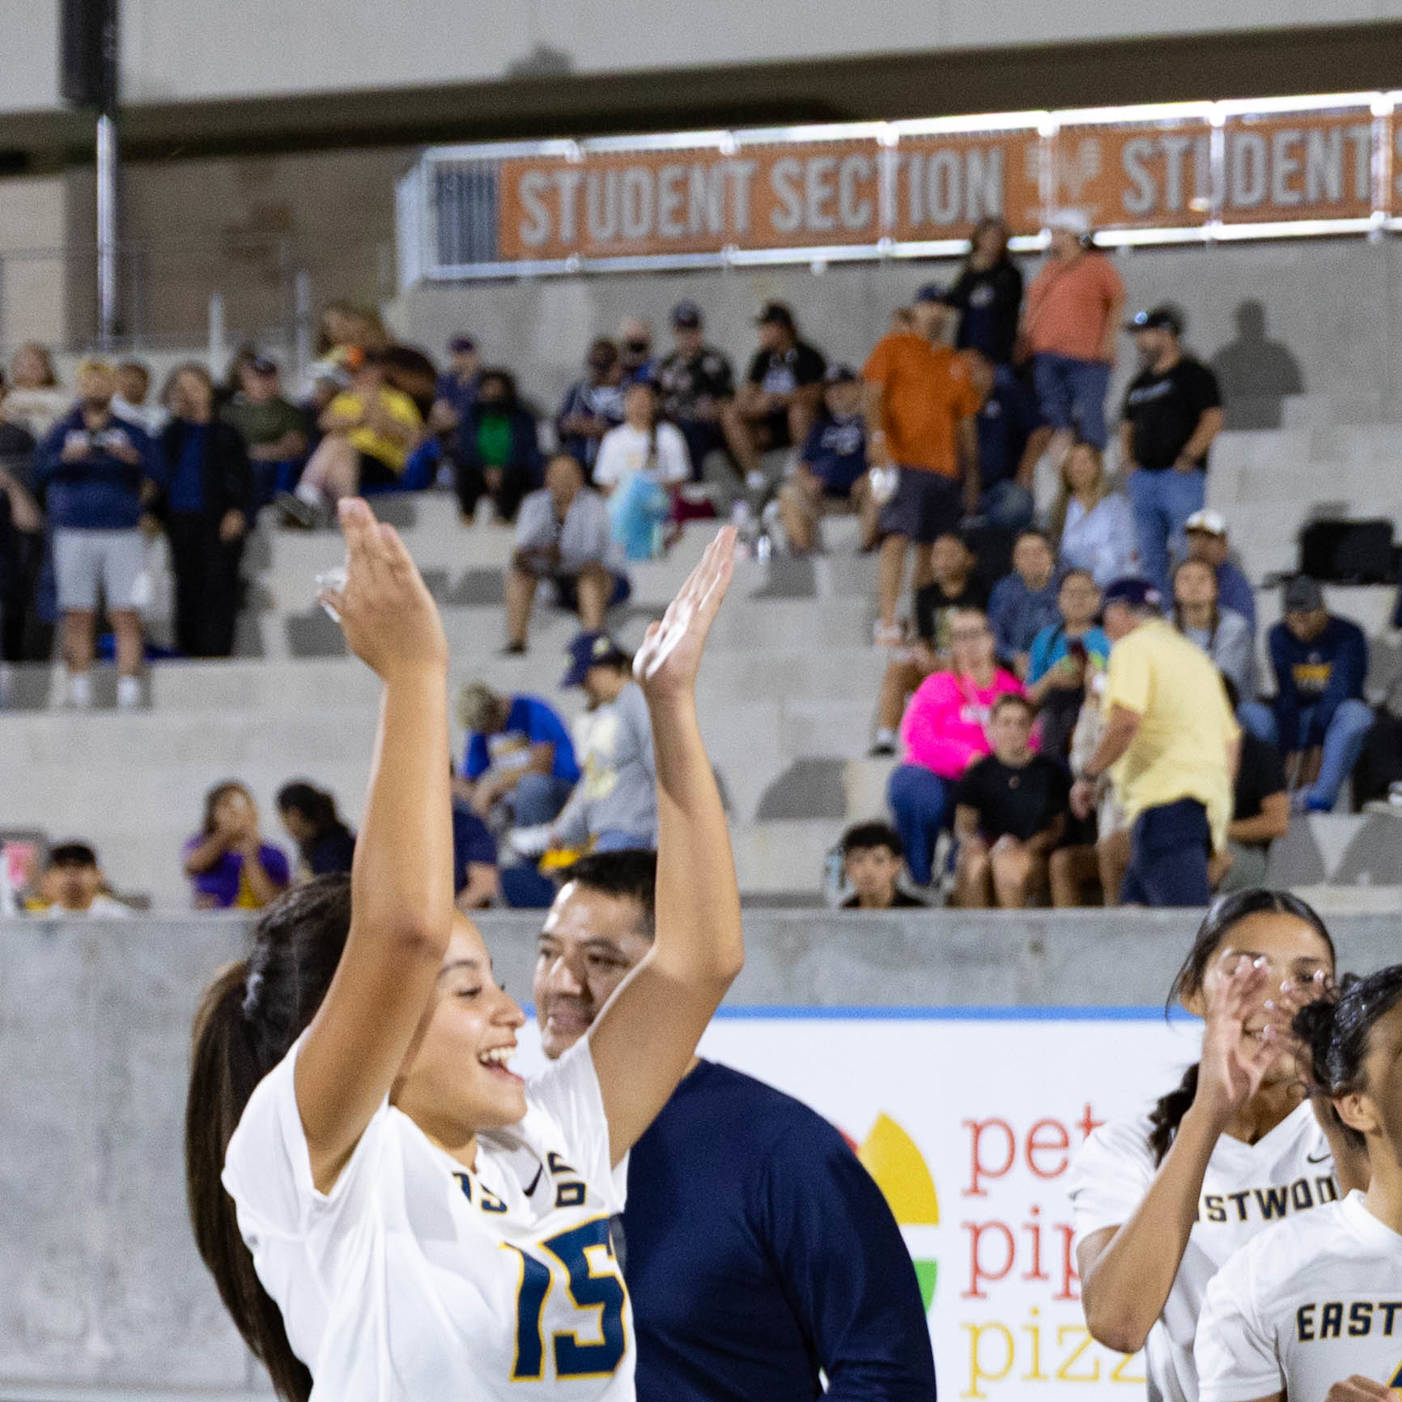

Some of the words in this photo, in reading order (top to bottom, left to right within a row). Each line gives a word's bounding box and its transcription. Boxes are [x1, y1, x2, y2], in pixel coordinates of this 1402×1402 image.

[518, 158, 757, 249] STUDENT
[768, 147, 1003, 237] SECTION
[1121, 122, 1372, 219] STUDENT
[498, 1212, 627, 1382] 15
